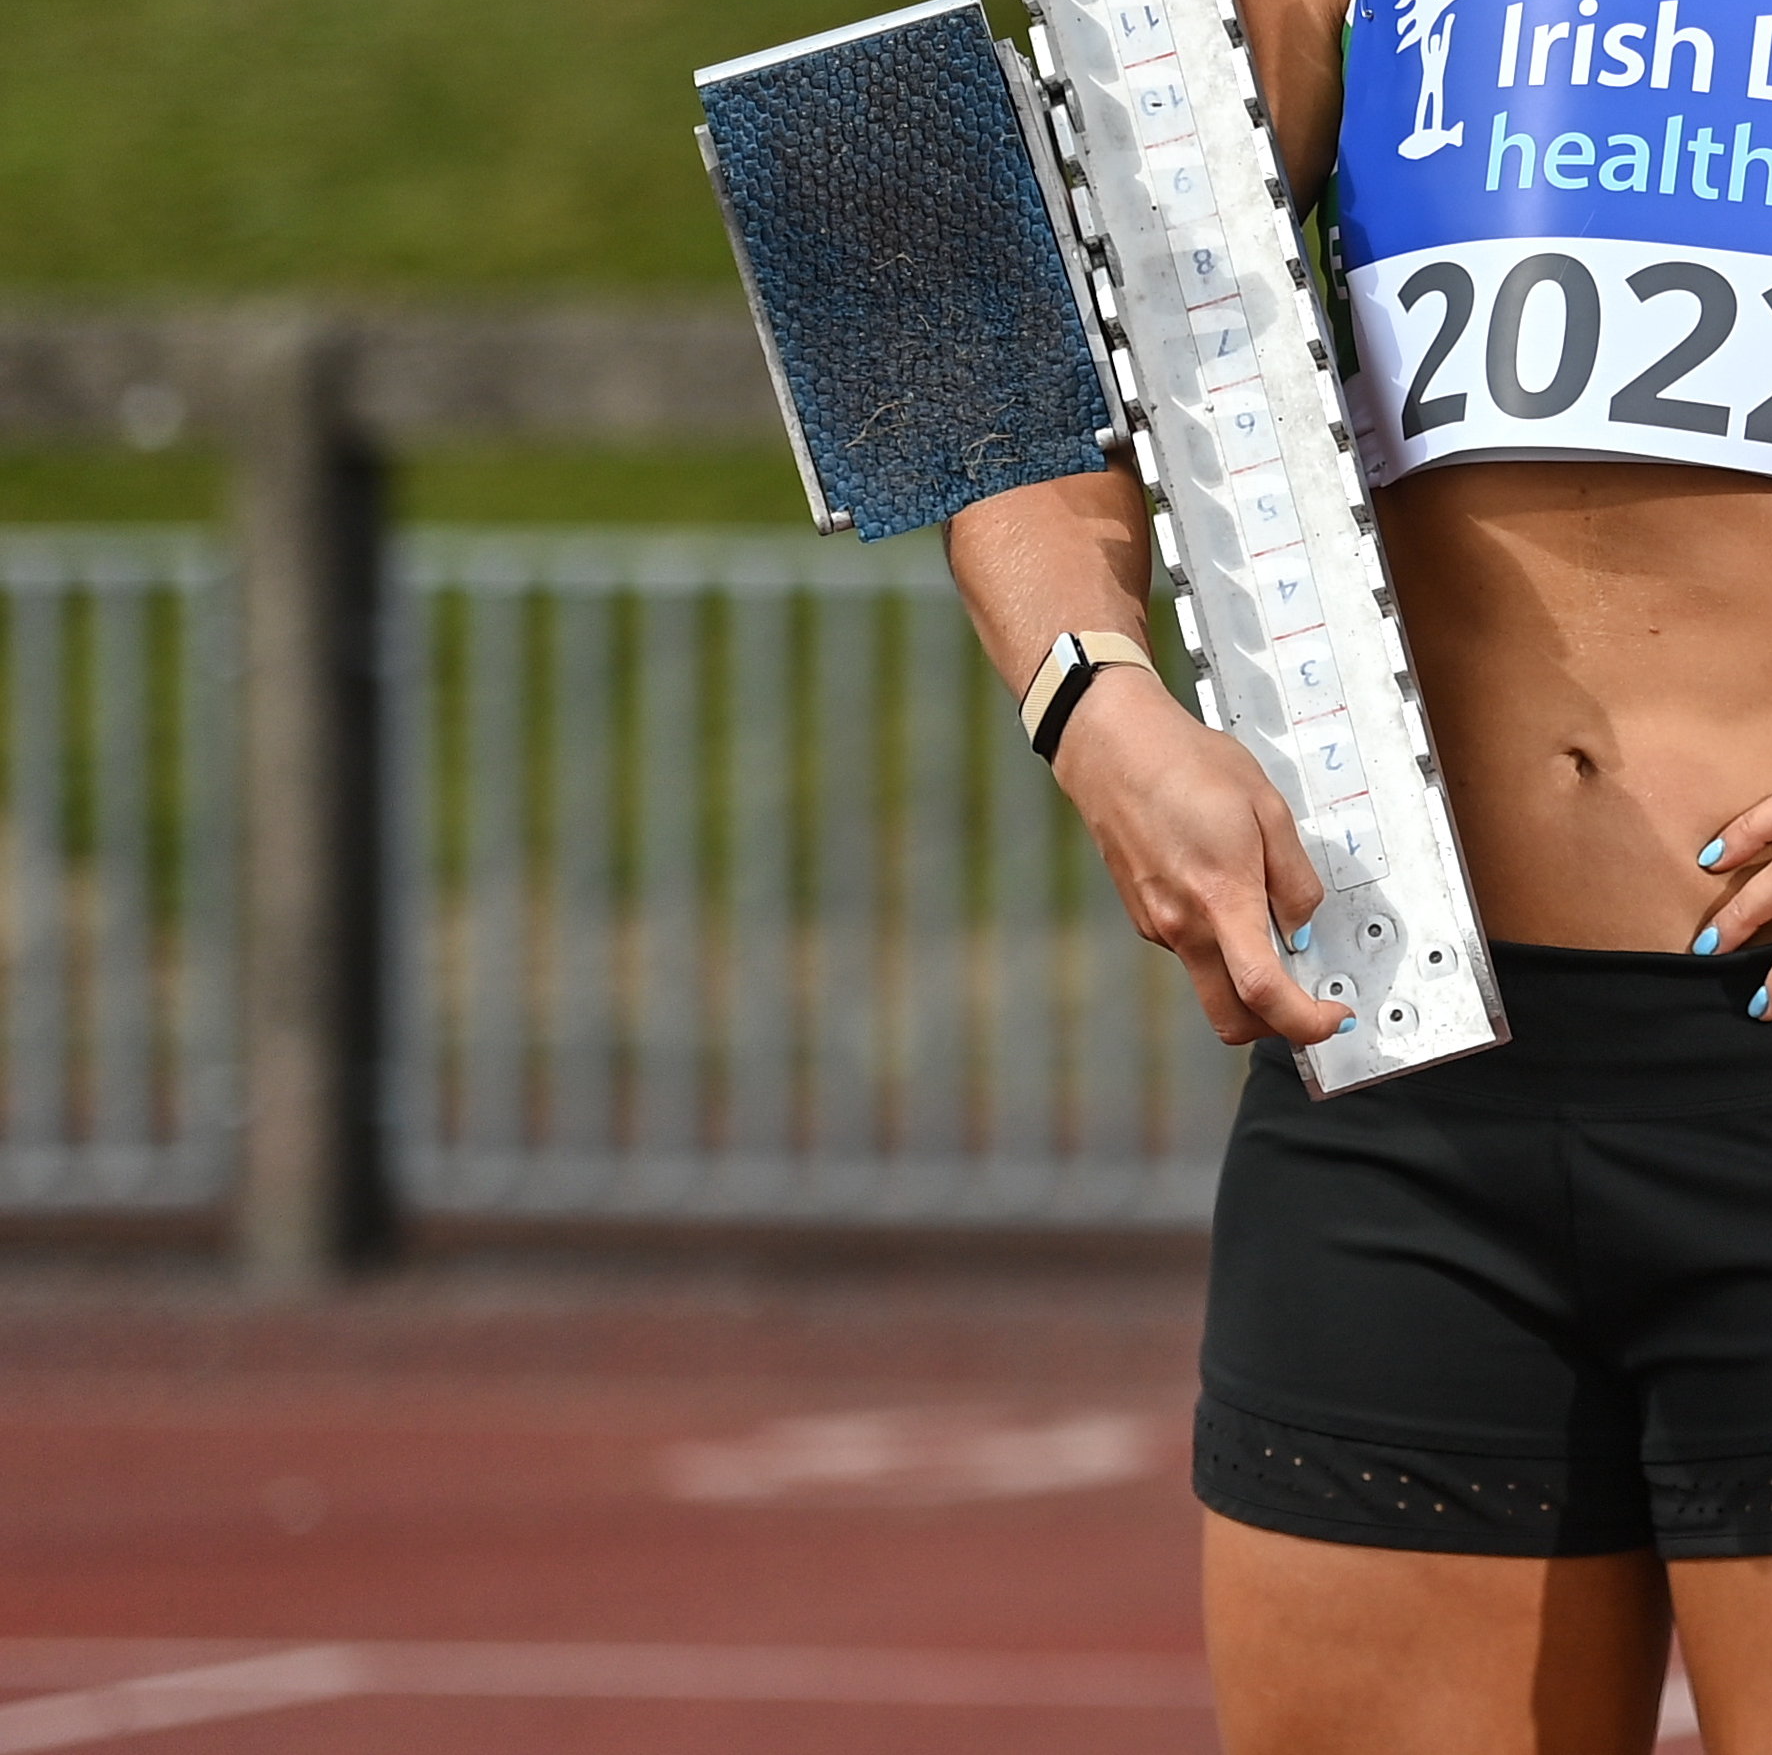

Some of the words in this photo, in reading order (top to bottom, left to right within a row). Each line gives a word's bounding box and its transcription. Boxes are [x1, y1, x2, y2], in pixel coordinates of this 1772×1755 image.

[1119, 5, 1160, 37] 11
[1140, 84, 1183, 116] 10
[1173, 167, 1192, 194] 9
[1193, 248, 1215, 275] 8
[1217, 329, 1239, 358] 7
[1235, 412, 1255, 438] 6
[1257, 494, 1277, 521] 5
[1277, 579, 1299, 605] 4
[1300, 659, 1320, 687] 3
[1319, 743, 1344, 771] 2
[1345, 829, 1361, 856] 1
